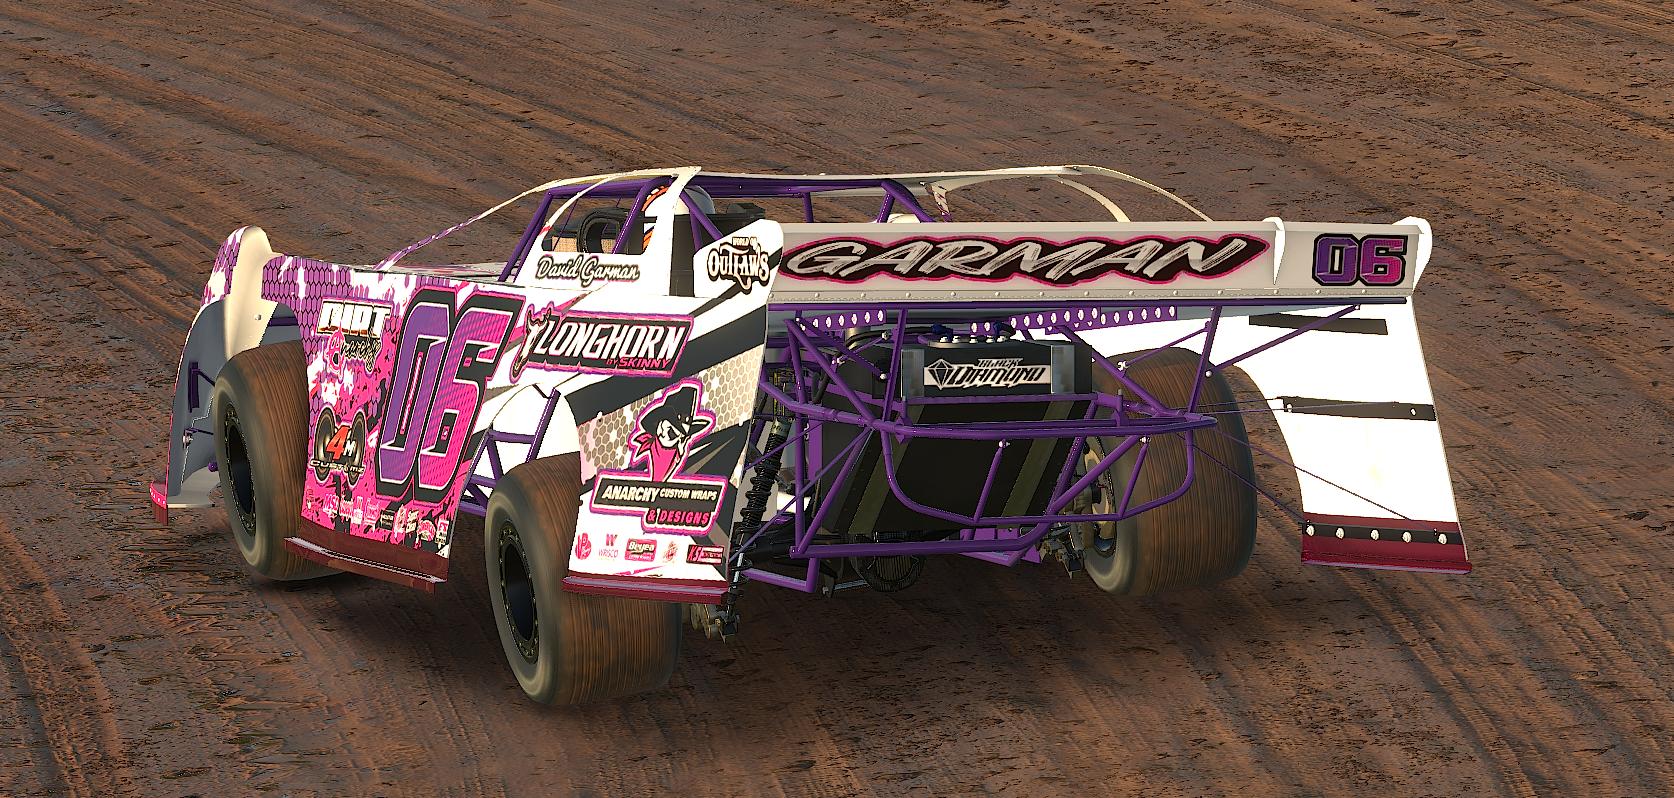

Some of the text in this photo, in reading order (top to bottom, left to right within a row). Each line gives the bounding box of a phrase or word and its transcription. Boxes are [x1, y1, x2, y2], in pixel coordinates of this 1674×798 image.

[536, 255, 640, 287] David Garman
[786, 237, 1247, 281] GARMAN
[1312, 233, 1408, 286] 06
[534, 317, 686, 361] LONGHORN
[619, 356, 670, 369] SKINNY
[376, 290, 522, 495] 06
[602, 485, 718, 503] ANARCHY CUSTOM WRAPS
[647, 509, 710, 525] & DESIGNS
